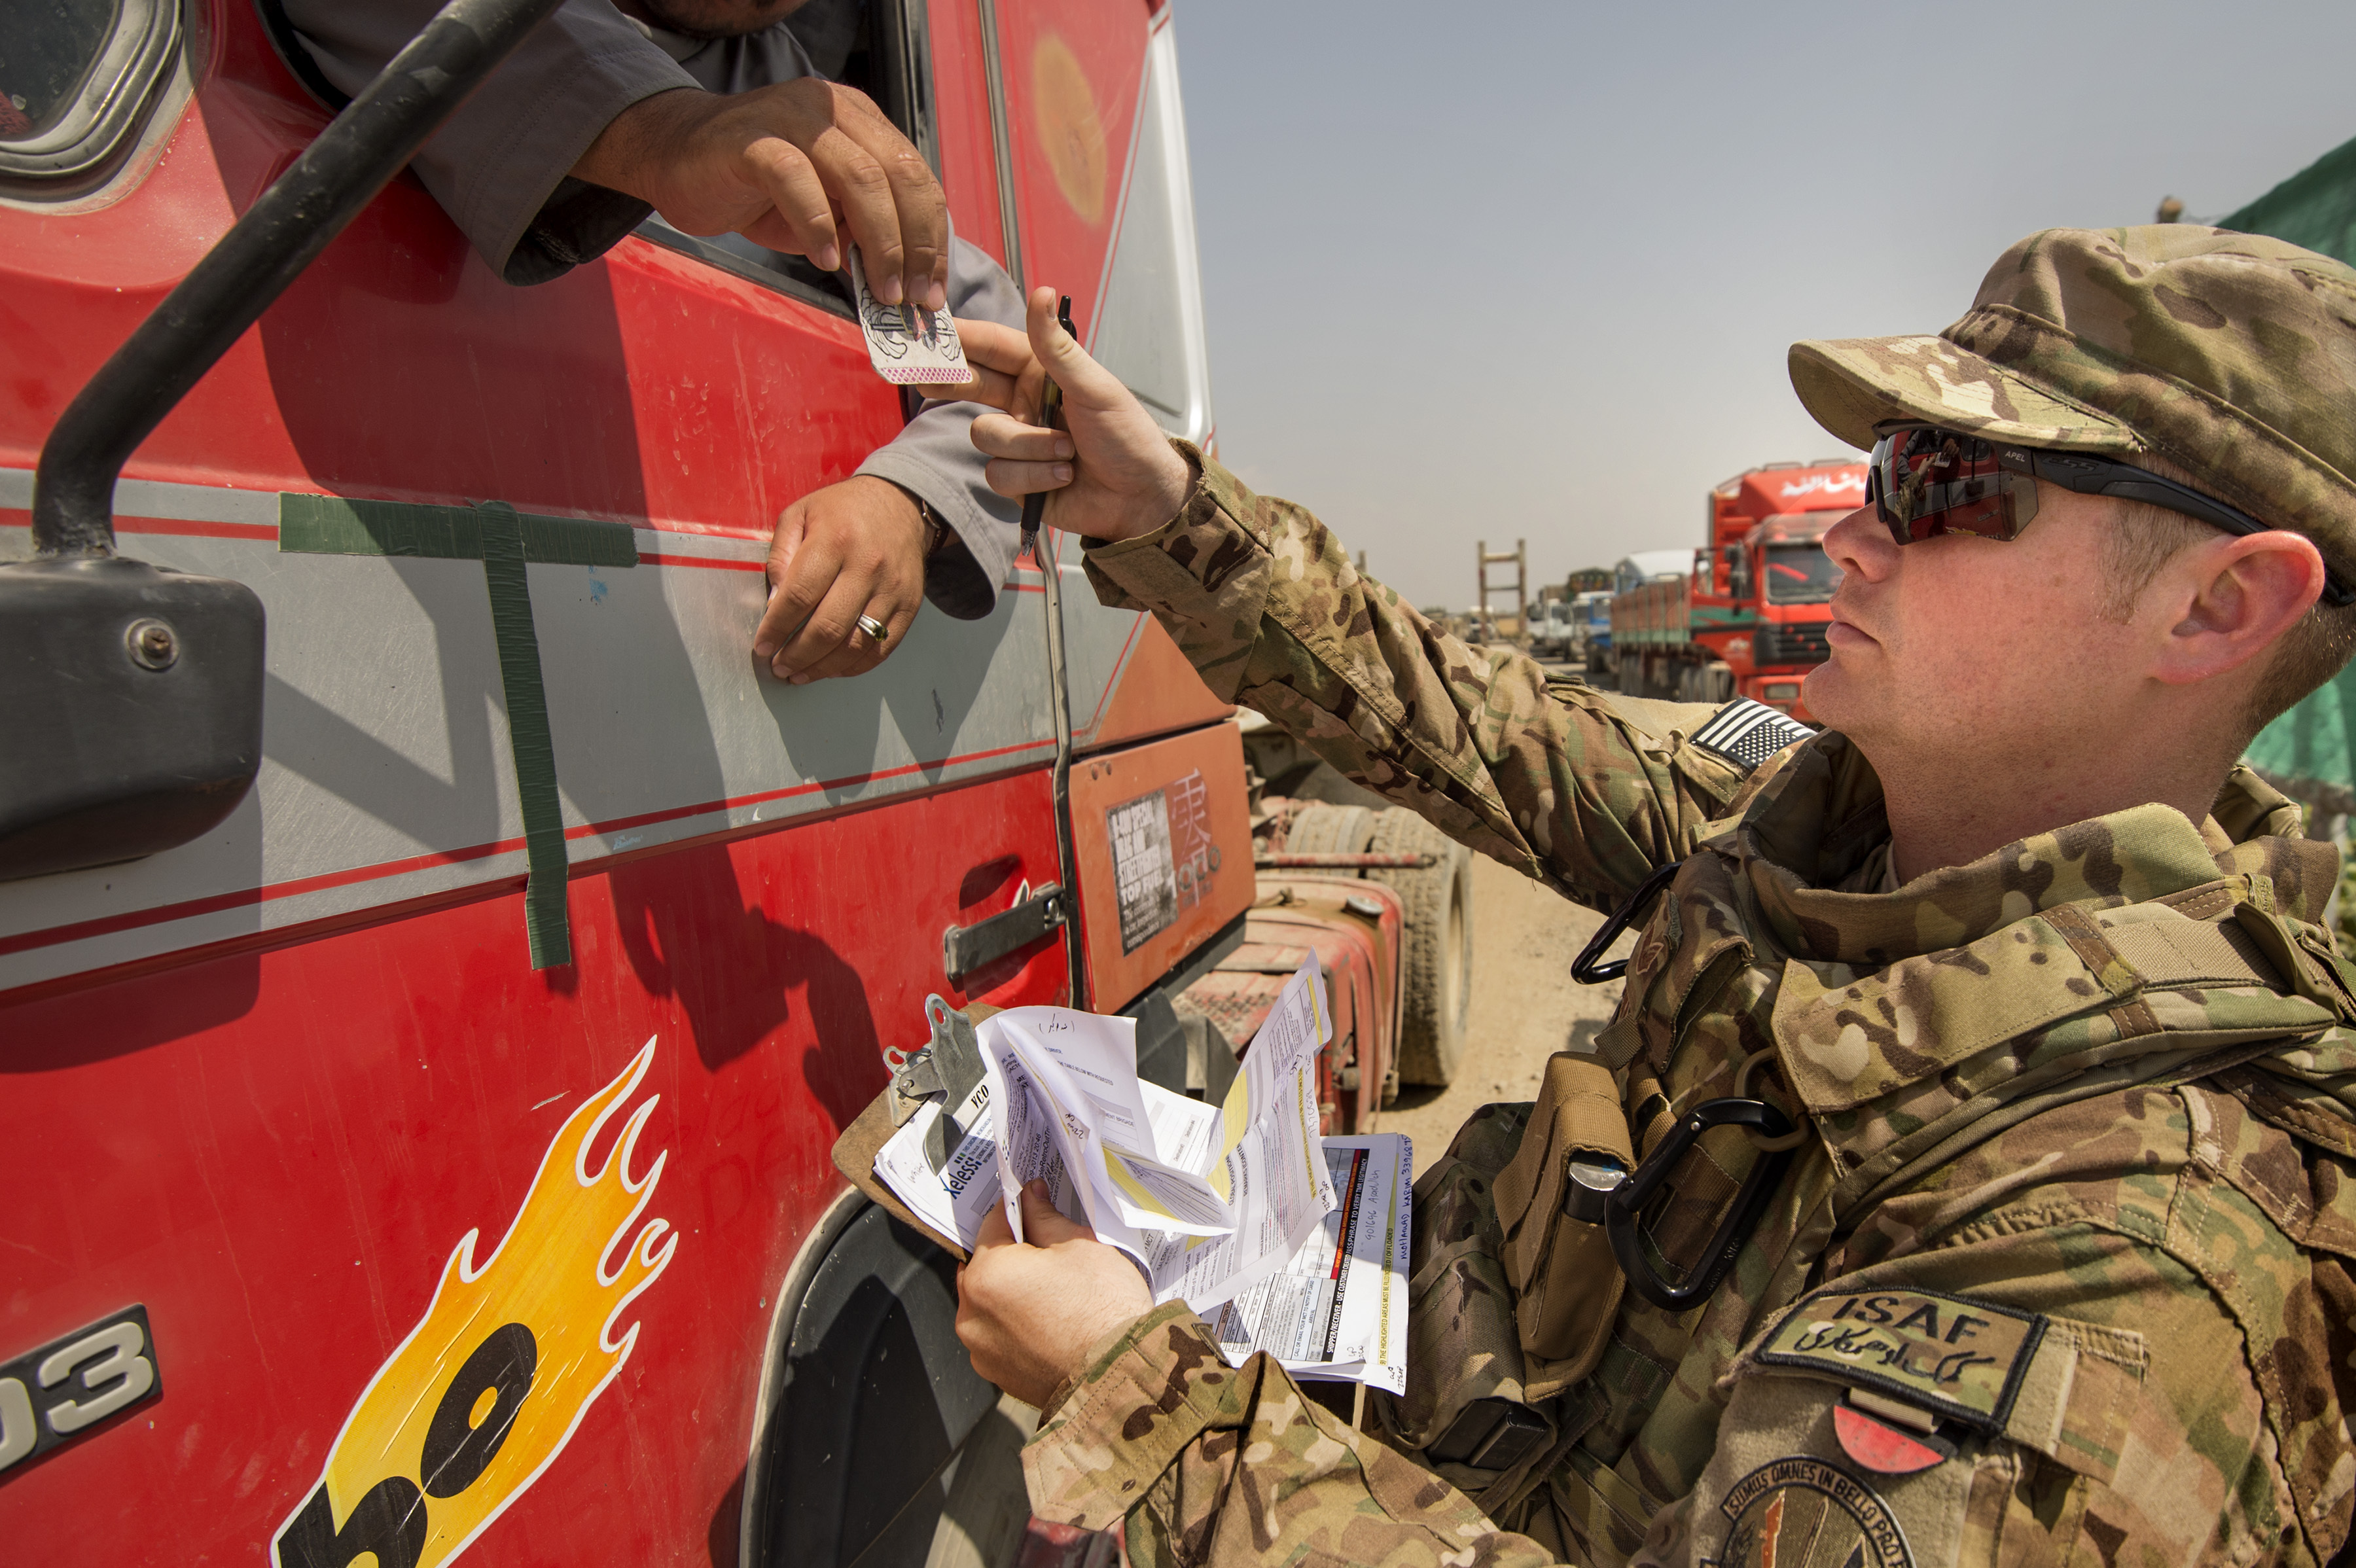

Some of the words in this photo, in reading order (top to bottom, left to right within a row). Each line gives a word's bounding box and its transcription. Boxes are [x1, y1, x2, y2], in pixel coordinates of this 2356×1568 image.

[2005, 450, 2026, 463] APEL
[1120, 878, 1142, 907] TOP
[1141, 866, 1164, 895] FUEL
[971, 1084, 990, 1110] VCO
[1033, 1132, 1042, 1152] 20:46
[1357, 1158, 1368, 1183] LEGITIMACY
[1353, 1192, 1361, 1209] VERIFY
[1351, 1210, 1358, 1219] TO
[1144, 1232, 1154, 1247] MCT
[1345, 1219, 1357, 1254] PASSPHRASE
[1342, 1253, 1351, 1269] CREATED
[1338, 1269, 1348, 1291] CUSTOMER
[1326, 1304, 1342, 1353] SHIPPER/RECEIVER
[1832, 1296, 1991, 1344] ISAF
[1380, 1318, 1388, 1348] HIGHLIGHTED
[1729, 1473, 1768, 1514] SUMUS
[1772, 1465, 1816, 1482] OMNES
[1819, 1468, 1834, 1490] IN
[1834, 1478, 1876, 1520] BELLO
[1871, 1520, 1901, 1556] PRO
